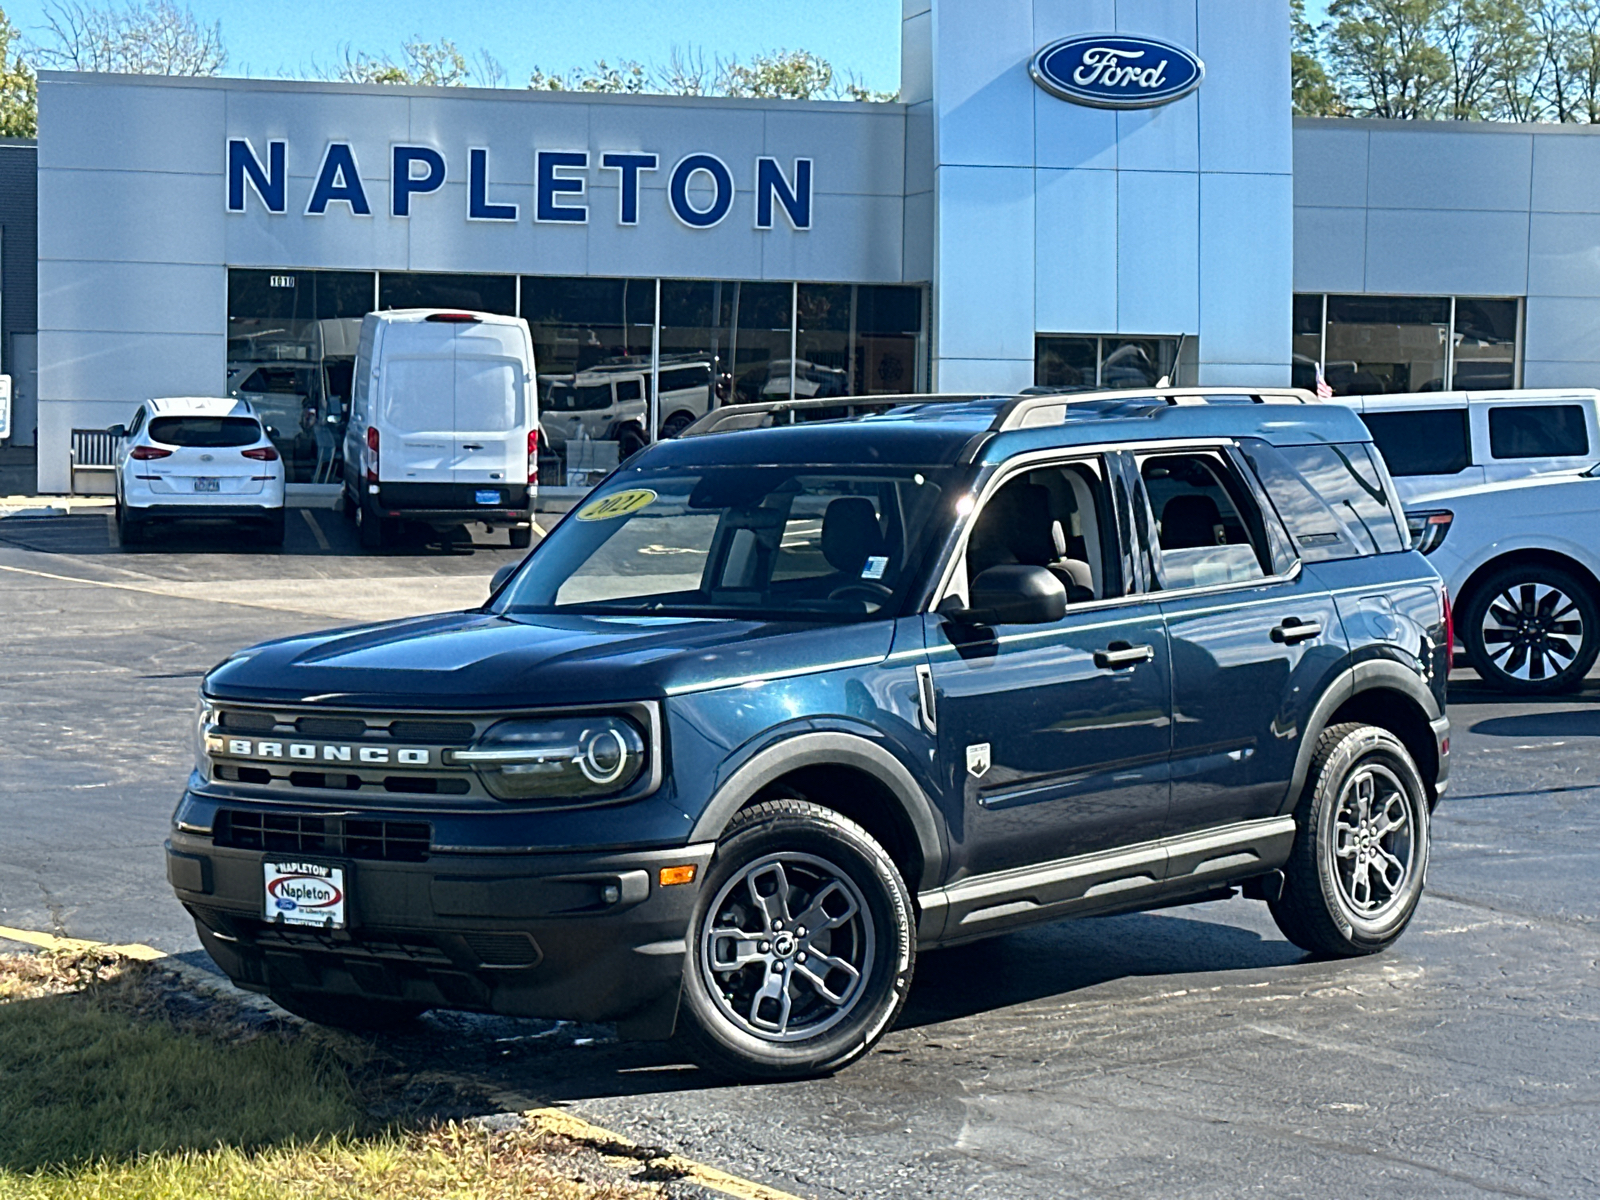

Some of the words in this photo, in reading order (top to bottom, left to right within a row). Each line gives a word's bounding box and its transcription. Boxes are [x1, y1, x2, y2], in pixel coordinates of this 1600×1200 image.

[1073, 47, 1167, 87] Ford
[225, 137, 813, 230] NAPLETON
[270, 275, 295, 287] 1010
[585, 493, 647, 516] 2021
[229, 740, 429, 764] BRONCO
[279, 863, 328, 876] NAPLETON
[281, 883, 330, 901] Napleton
